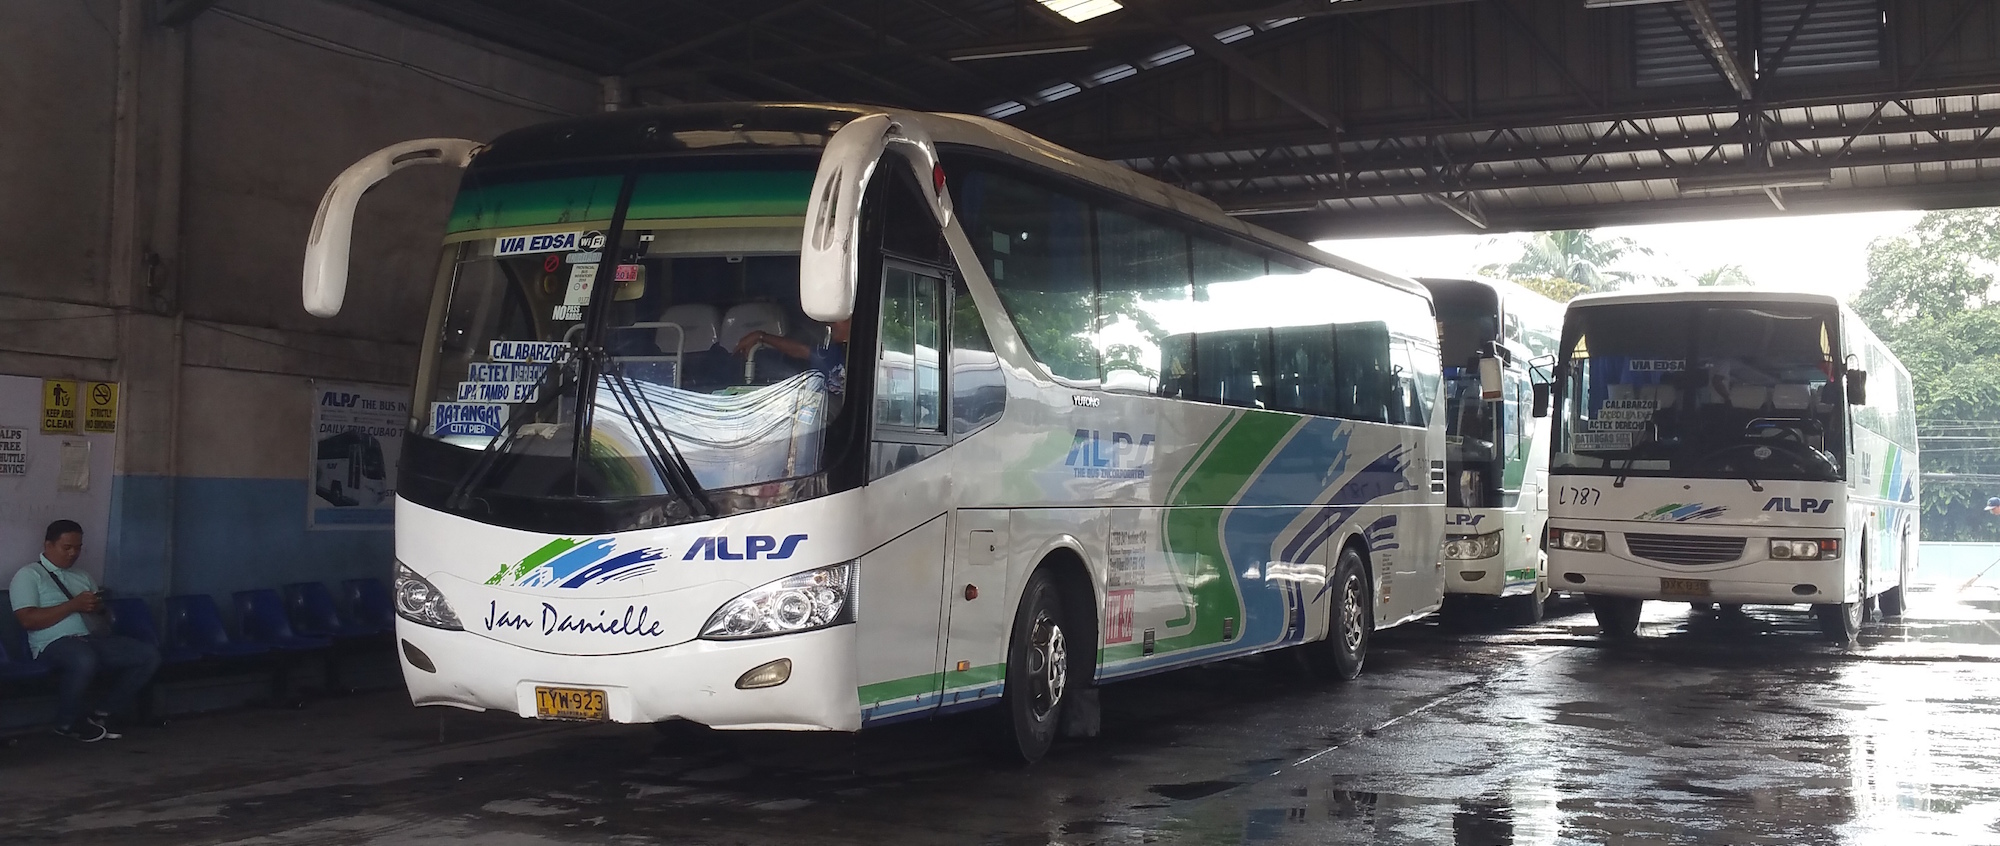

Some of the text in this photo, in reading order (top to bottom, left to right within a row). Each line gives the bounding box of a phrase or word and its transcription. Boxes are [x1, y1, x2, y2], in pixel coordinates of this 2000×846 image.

[500, 233, 576, 253] VIA EDSA
[552, 305, 567, 320] NO
[1631, 361, 1685, 370] VIA EDSA
[479, 384, 510, 400] TAMBO
[321, 391, 360, 408] ALPS
[362, 399, 377, 410] THE
[379, 401, 396, 411] BUS
[1072, 395, 1100, 408] YUTONG
[46, 409, 60, 418] KEEP
[90, 408, 113, 418] STRICTLY
[436, 404, 502, 431] BATANGAS
[45, 419, 74, 429] CLEAN
[319, 423, 346, 434] DAILY
[367, 426, 397, 438] CUBAO
[450, 424, 486, 434] CITY PIER
[0, 430, 22, 440] ALPS
[0, 441, 22, 451] FREE
[1065, 428, 1156, 469] ALPS
[1074, 468, 1086, 478] THE
[1762, 497, 1834, 514] ALPS
[682, 534, 808, 561] ALPS
[484, 600, 665, 637] Jan Danielle
[538, 690, 604, 711] TYW-923
